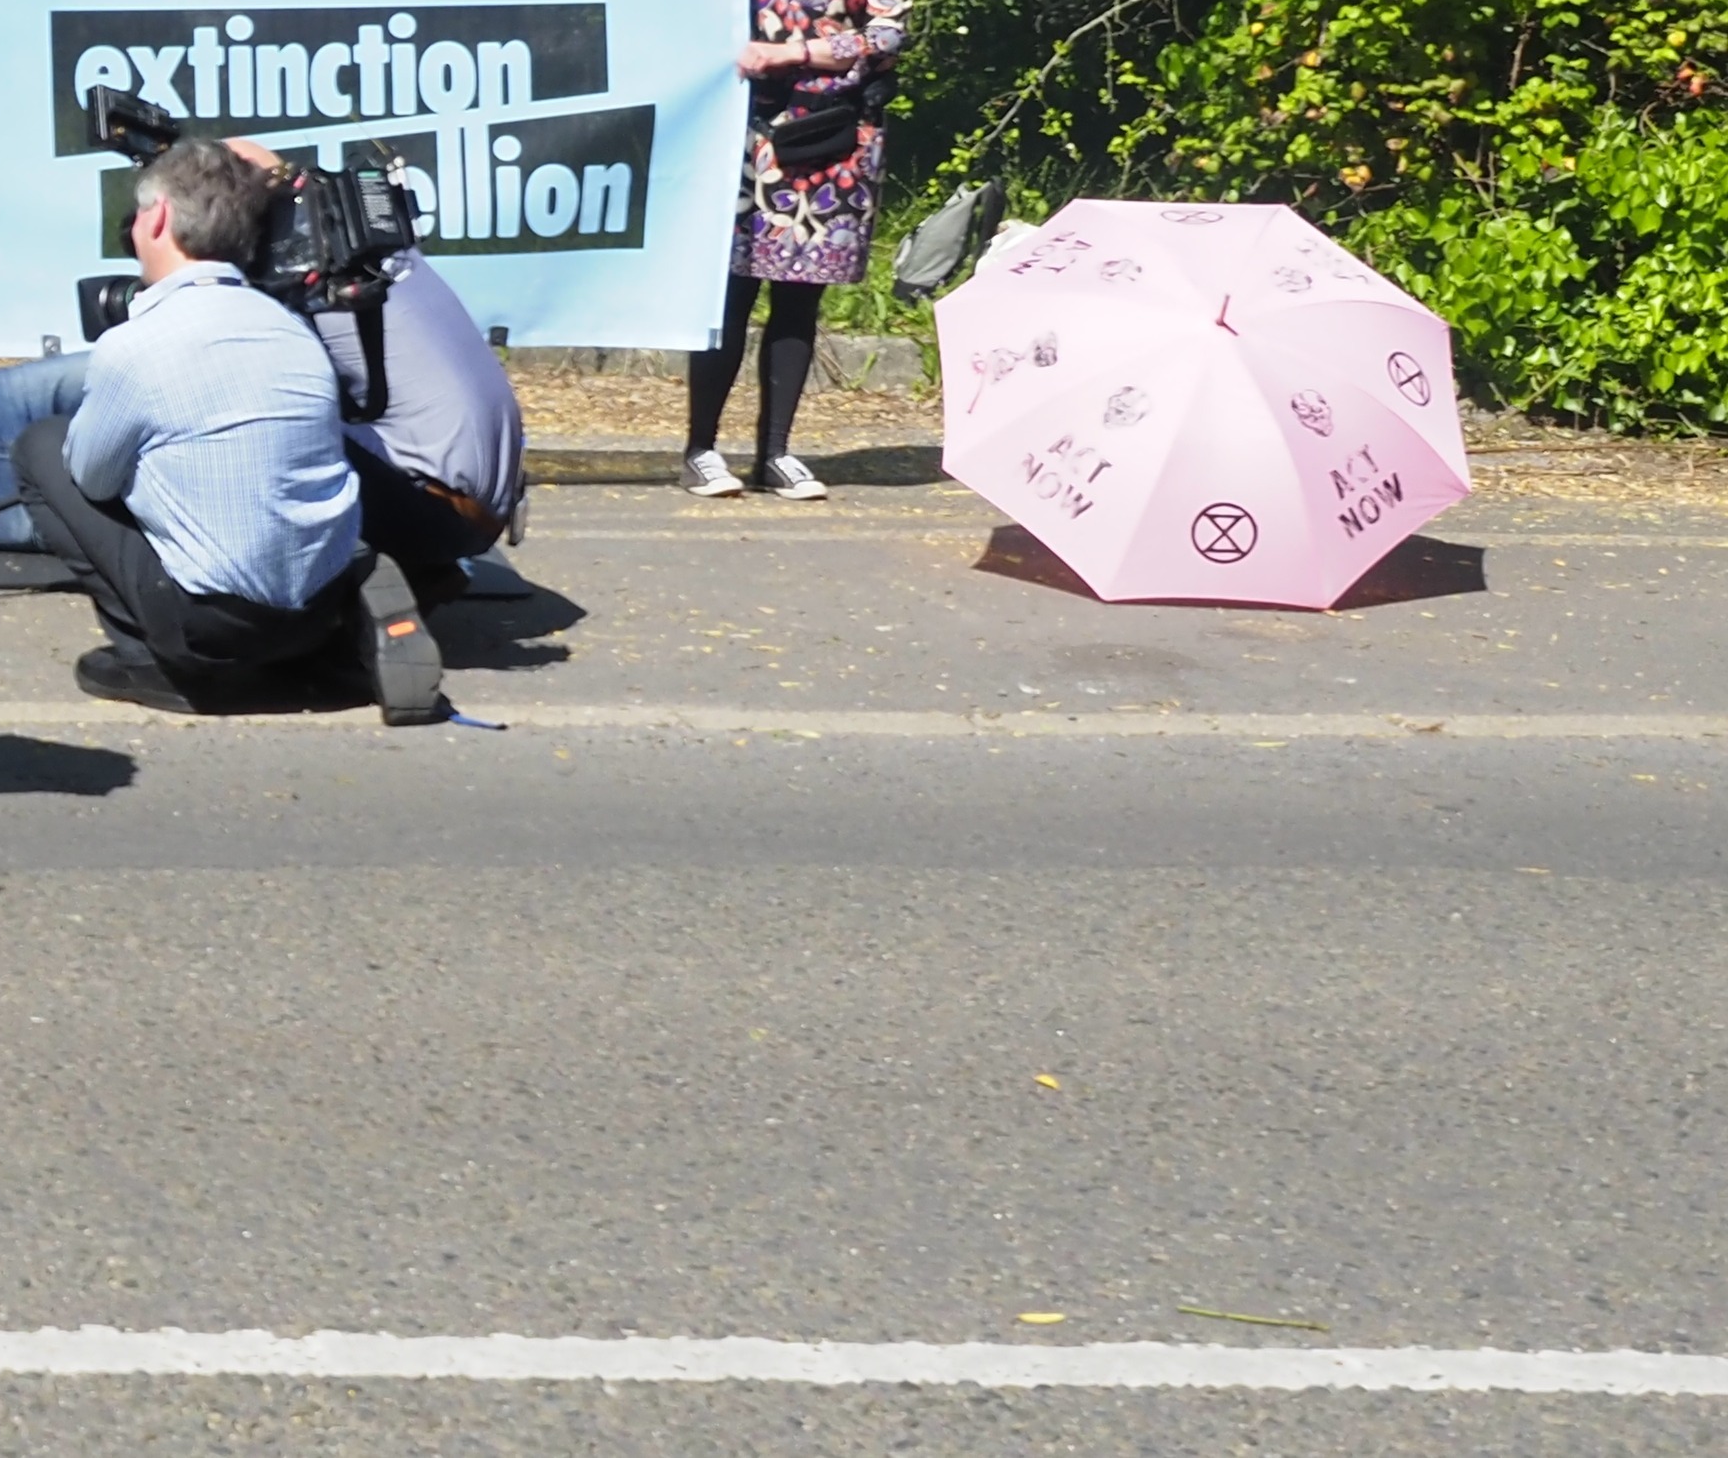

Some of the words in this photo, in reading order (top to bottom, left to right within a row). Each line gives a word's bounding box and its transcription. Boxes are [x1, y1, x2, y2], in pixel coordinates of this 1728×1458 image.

[74, 12, 532, 119] extinction
[1022, 452, 1093, 519] NOW
[1047, 434, 1112, 483] ACT
[1329, 444, 1379, 500] ACT
[1337, 471, 1403, 540] NOW
